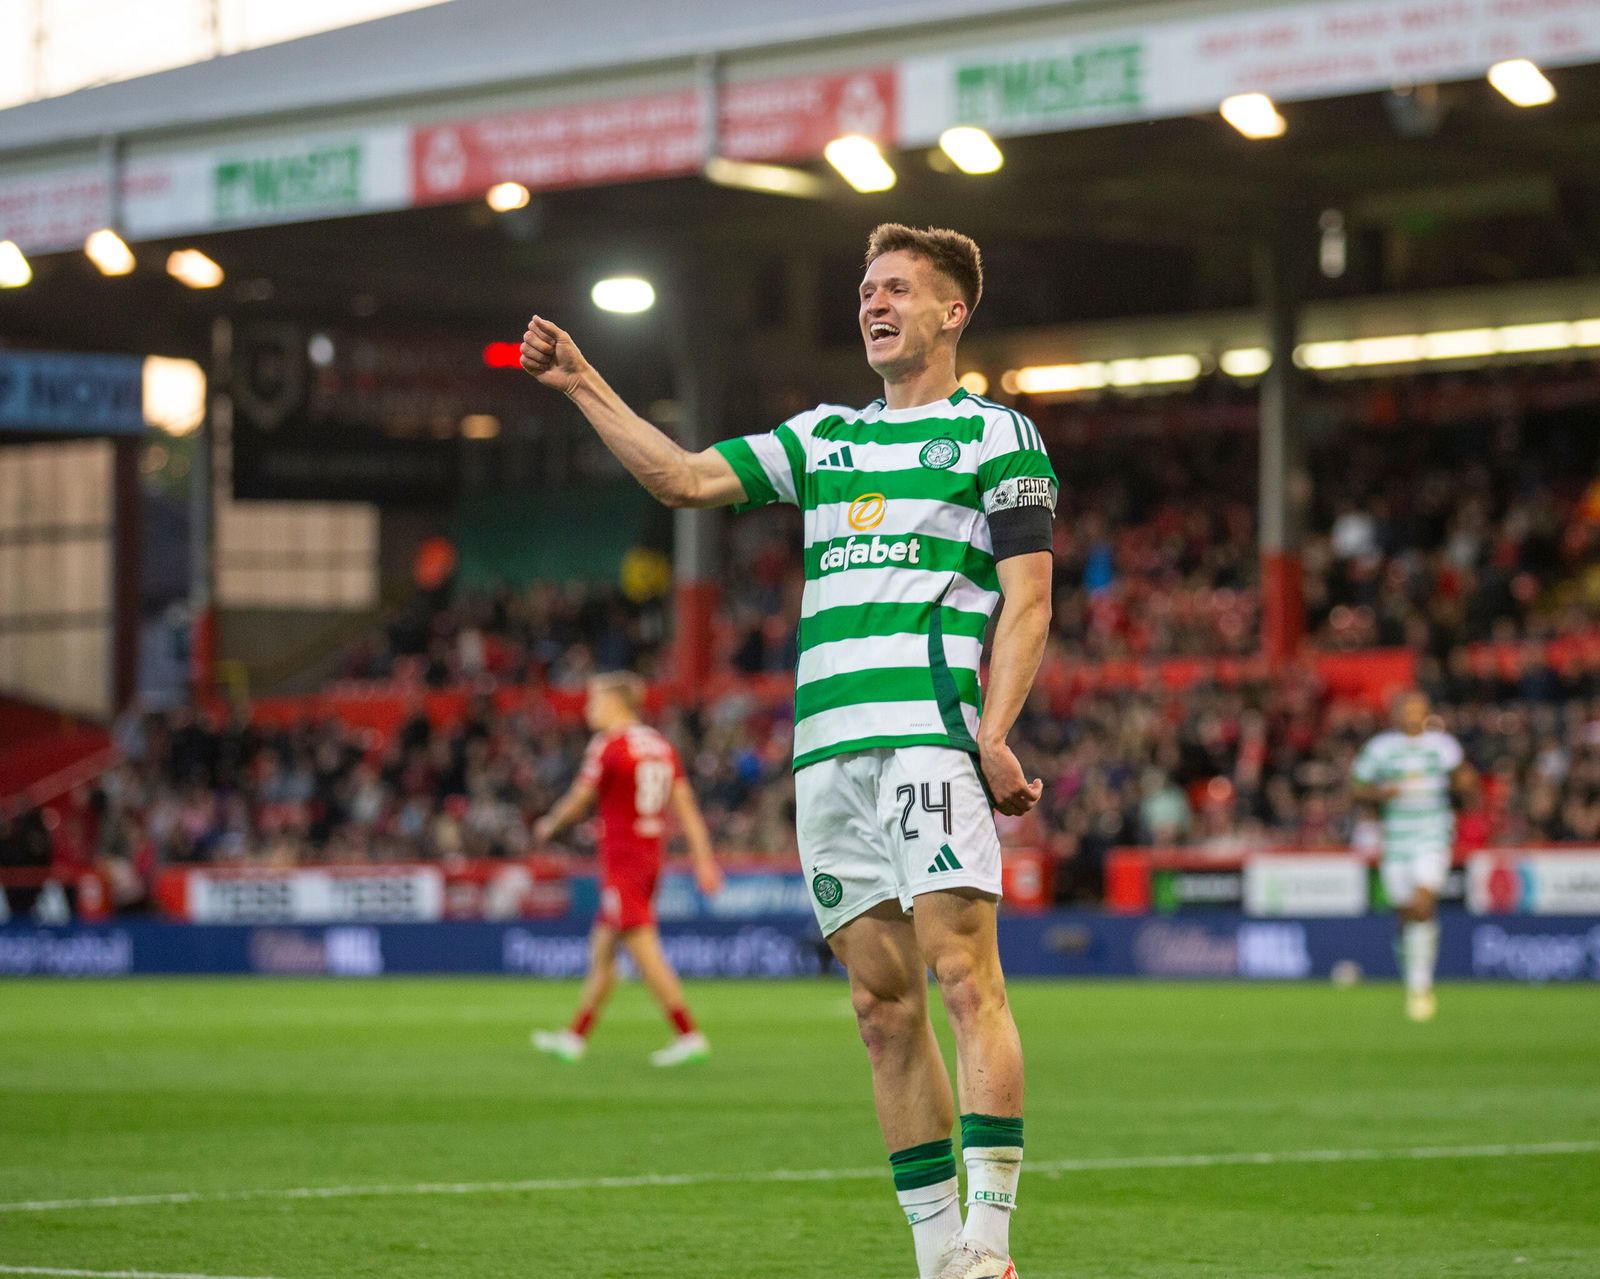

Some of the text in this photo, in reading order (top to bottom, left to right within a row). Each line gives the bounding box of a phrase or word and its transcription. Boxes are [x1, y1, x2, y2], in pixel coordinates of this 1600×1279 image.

[1017, 478, 1048, 494] CELTIC
[820, 536, 920, 571] dafabet
[896, 781, 952, 841] 24
[974, 1190, 1013, 1204] CELTIC
